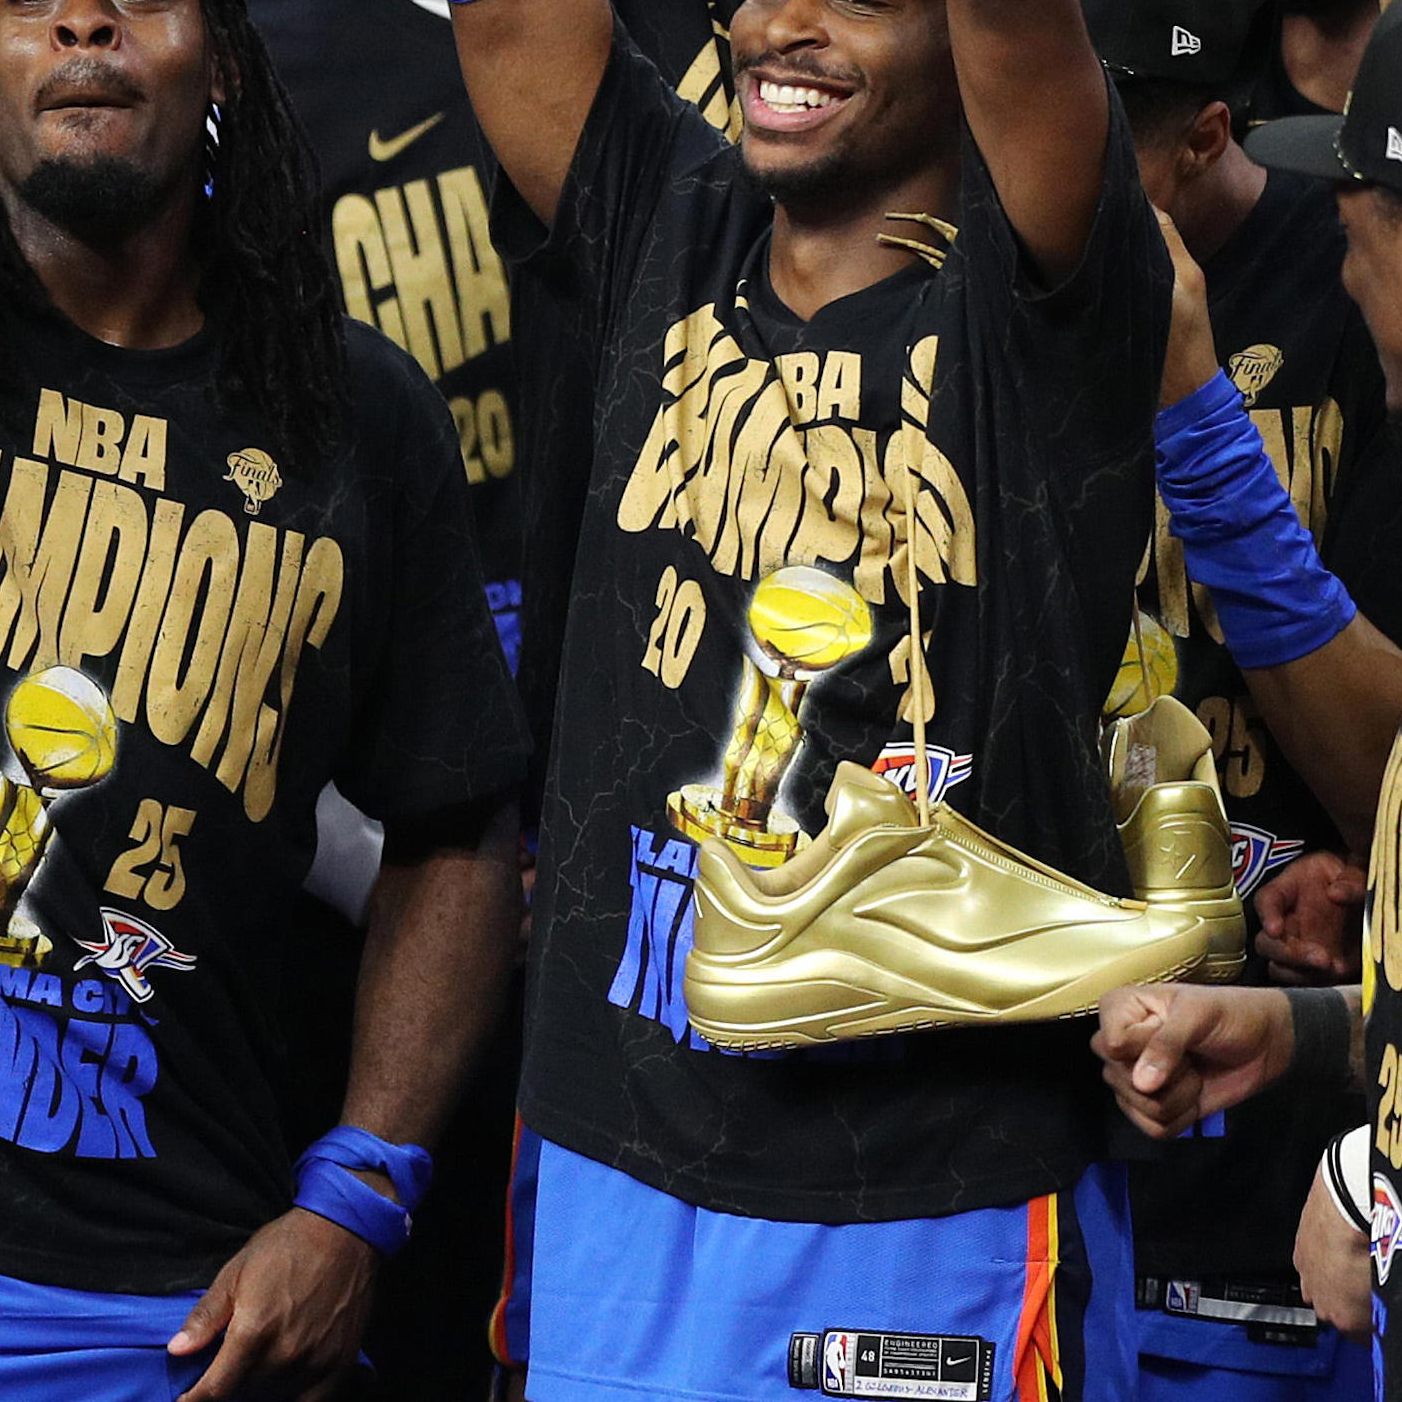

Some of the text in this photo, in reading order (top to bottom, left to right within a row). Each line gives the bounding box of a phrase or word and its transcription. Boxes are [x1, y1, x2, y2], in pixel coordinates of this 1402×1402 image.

[332, 165, 512, 383] CHA
[32, 387, 168, 490] NBA
[774, 350, 862, 426] BA
[221, 452, 283, 488] Finals
[641, 565, 708, 690] 20
[103, 799, 197, 911] 25
[860, 1349, 876, 1363] 48
